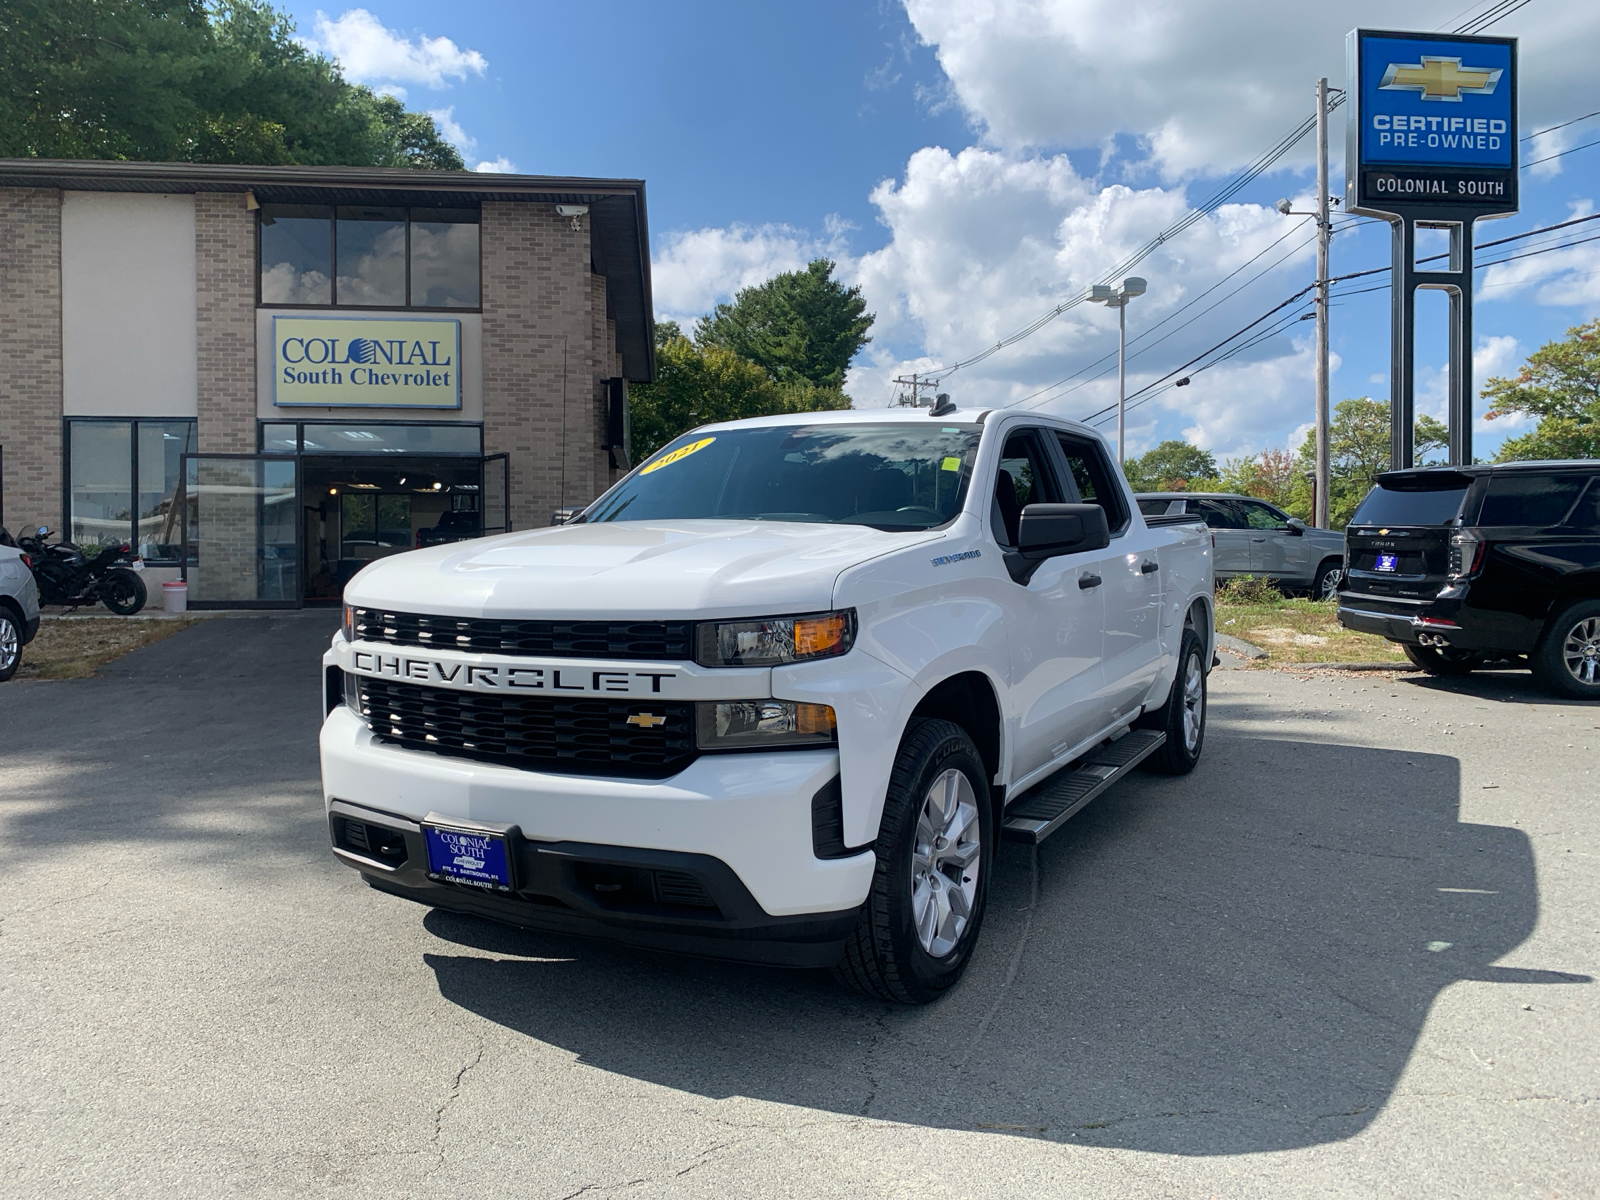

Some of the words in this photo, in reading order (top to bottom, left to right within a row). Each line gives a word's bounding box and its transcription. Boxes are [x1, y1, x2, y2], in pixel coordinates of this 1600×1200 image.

[1373, 115, 1507, 134] CERTIFIED
[1380, 132, 1501, 150] PRE-OWNED
[1376, 178, 1449, 194] COLONIAL
[1458, 180, 1504, 195] SOUTH
[282, 337, 451, 366] COLONIAL
[283, 366, 343, 385] South
[350, 367, 451, 387] Chevrolet
[652, 442, 701, 470] 2021
[929, 549, 982, 567] SILVERADO
[354, 651, 677, 693] CHEVROLET
[935, 739, 979, 766] COOPER
[440, 833, 492, 850] COLONIAL
[449, 844, 485, 859] SOUTH
[455, 858, 483, 867] CHEVROLET
[445, 875, 474, 886] COLONIAL
[473, 880, 493, 889] SOUTH
